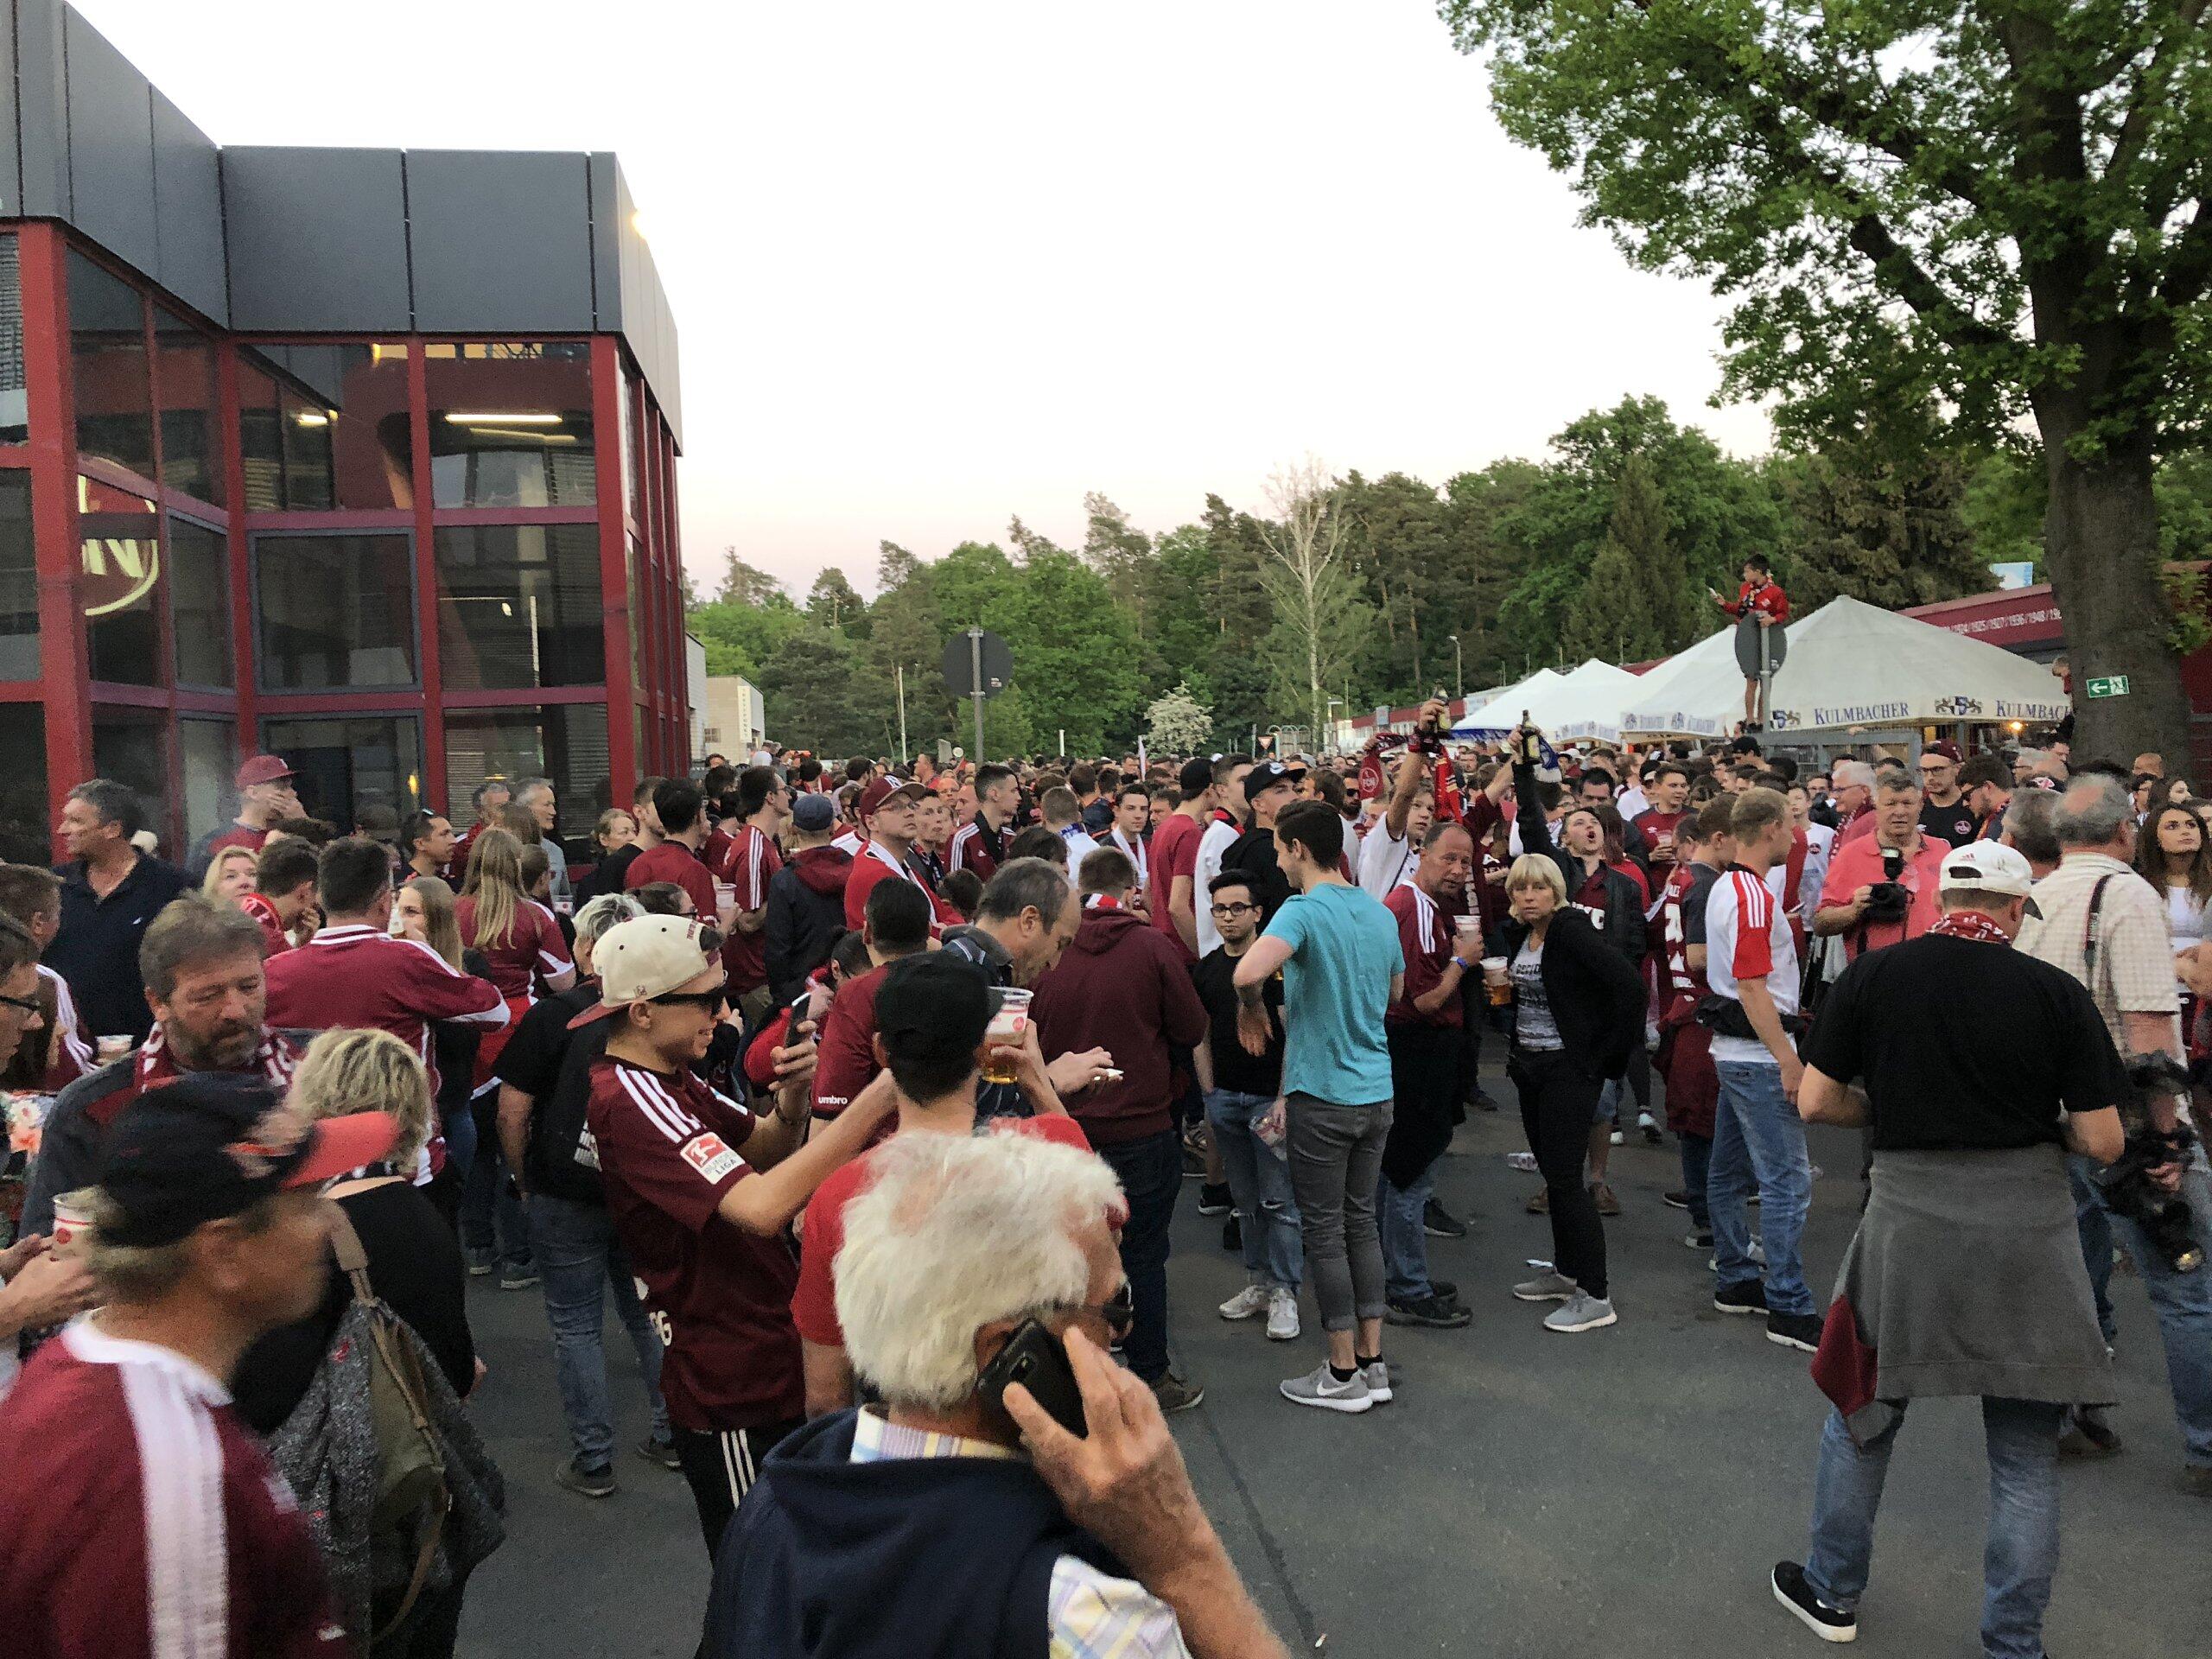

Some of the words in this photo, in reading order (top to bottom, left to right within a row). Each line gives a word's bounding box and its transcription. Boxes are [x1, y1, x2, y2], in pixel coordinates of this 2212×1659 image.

[1815, 702, 1909, 725] KULMBACHER
[817, 1095, 849, 1105] umbro
[715, 1159, 737, 1175] LIGA
